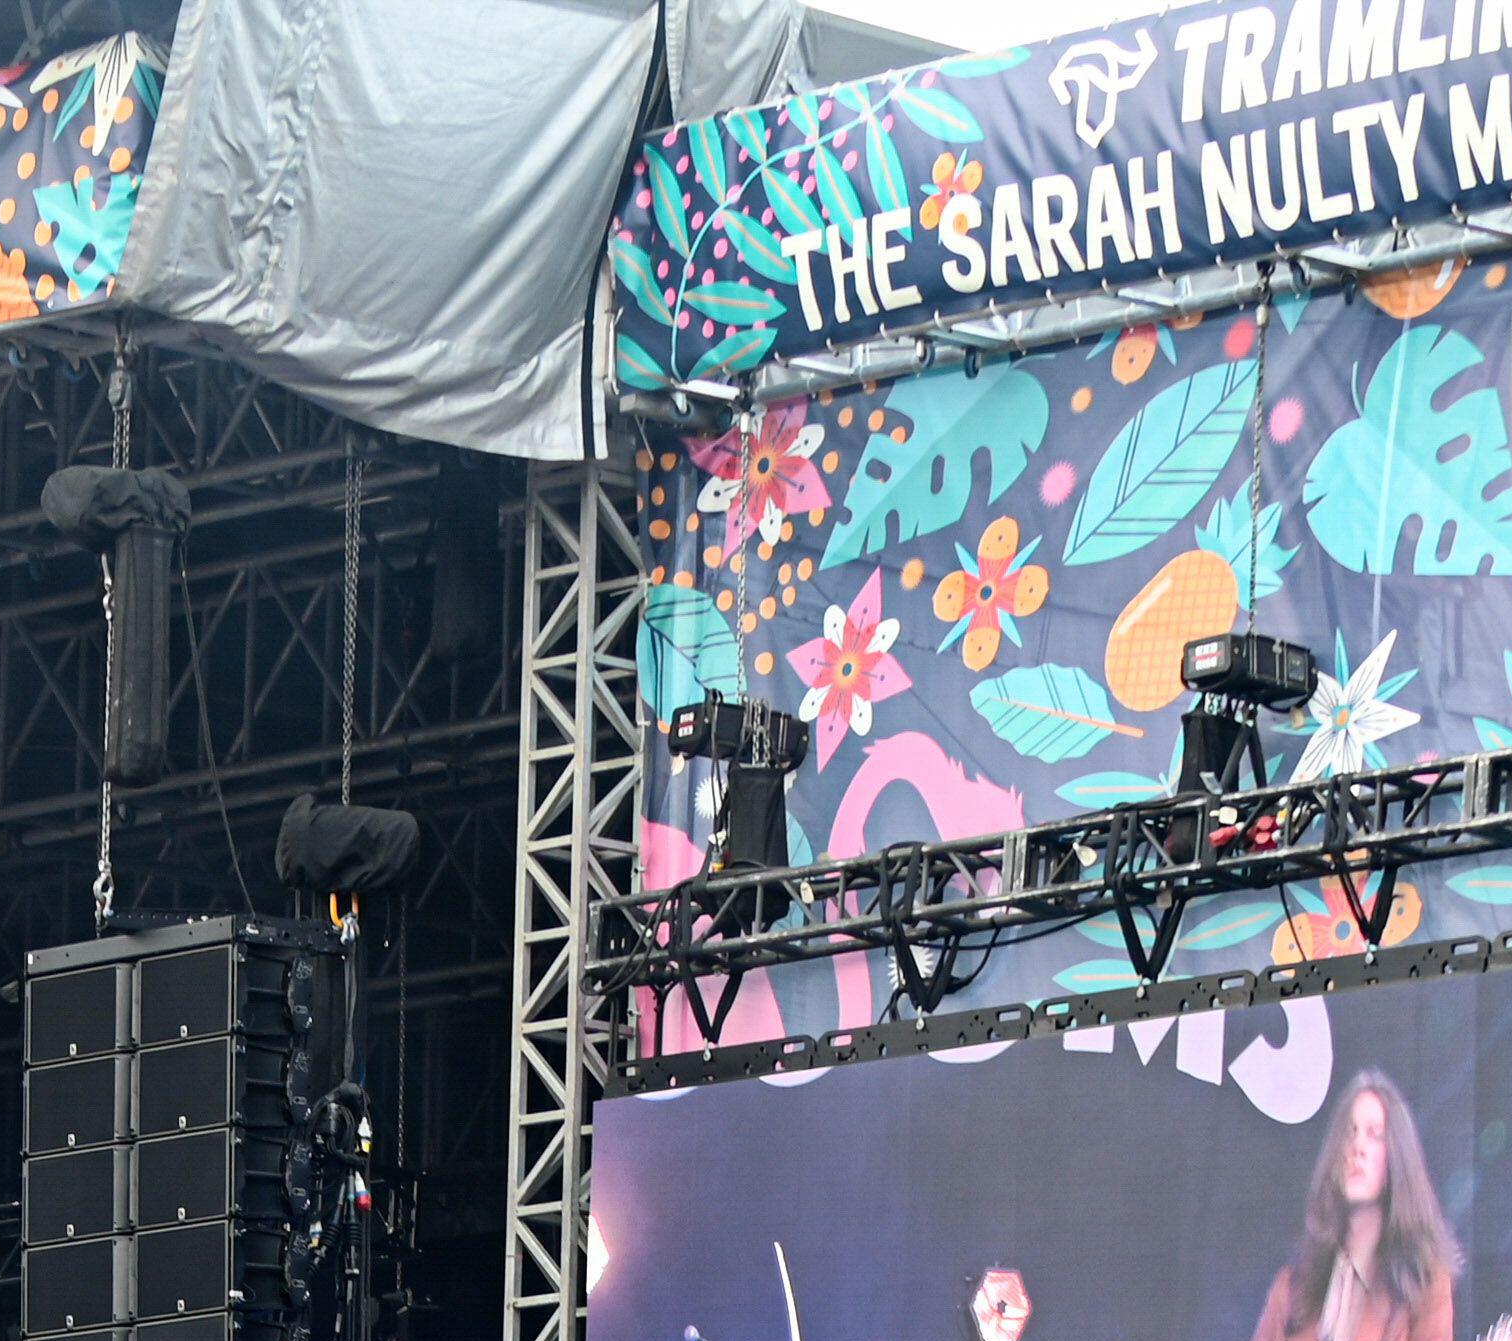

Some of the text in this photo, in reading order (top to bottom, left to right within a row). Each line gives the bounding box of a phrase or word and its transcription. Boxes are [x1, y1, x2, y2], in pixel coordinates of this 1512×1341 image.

[780, 207, 922, 332] THE
[939, 149, 1181, 294] SARAH
[1201, 94, 1425, 250] NULTY
